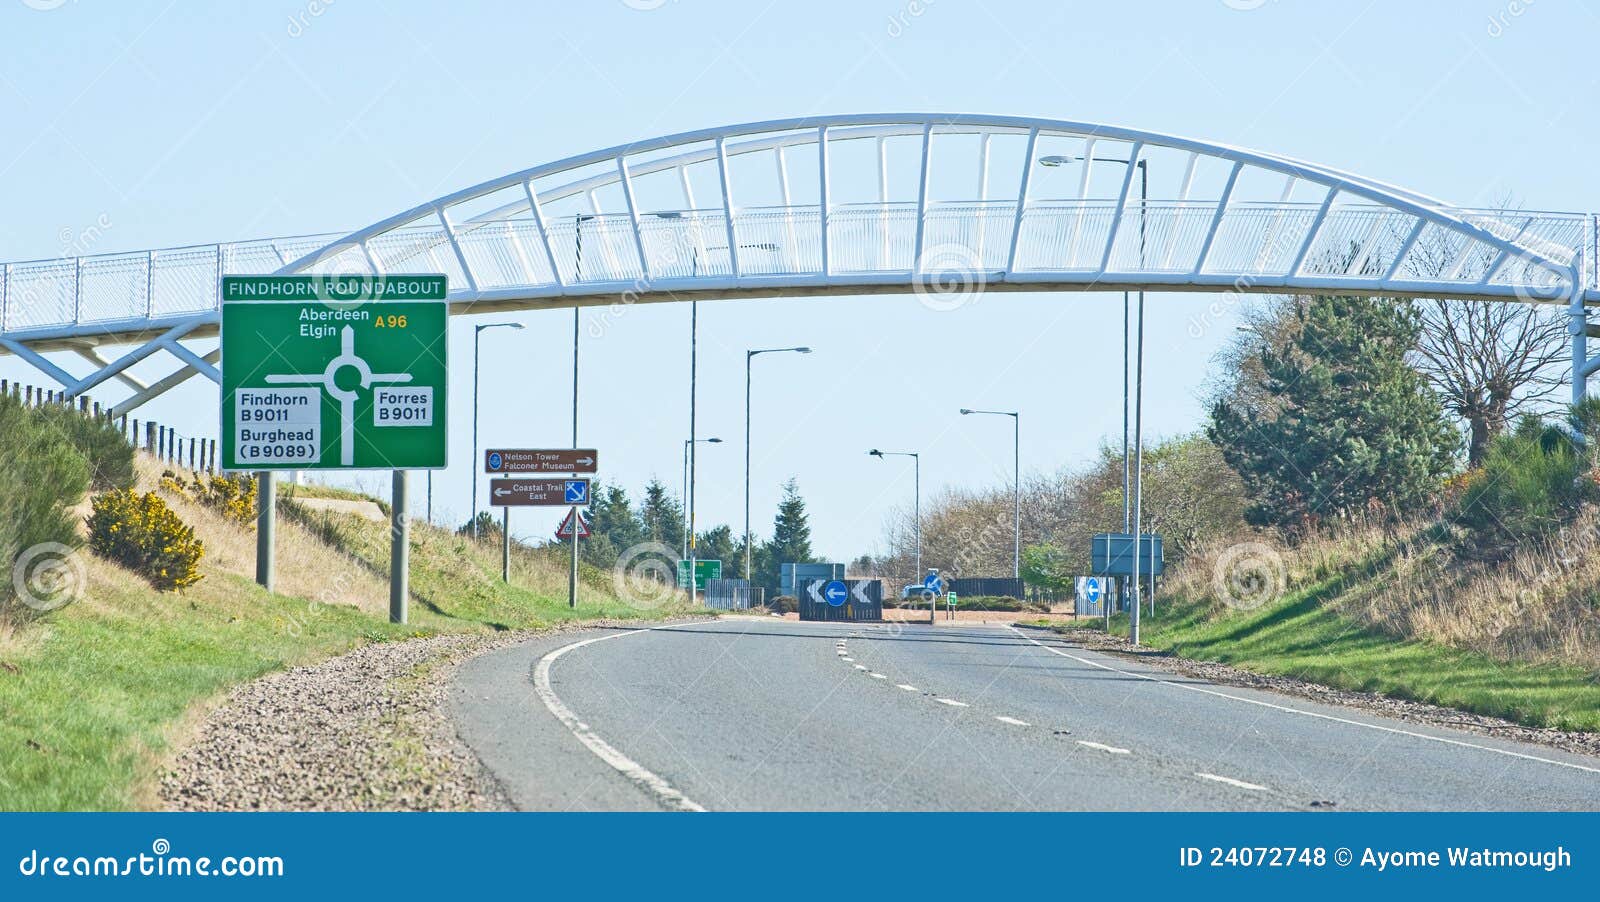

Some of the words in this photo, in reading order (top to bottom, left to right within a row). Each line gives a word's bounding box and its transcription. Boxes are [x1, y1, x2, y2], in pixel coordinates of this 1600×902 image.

[229, 282, 318, 296] FINDHORN
[325, 281, 441, 296] ROUNDABOUT
[299, 308, 369, 321] Aberdeen
[300, 324, 336, 339] Elgin
[241, 393, 308, 406] Findhorn
[380, 392, 428, 404] Forres
[241, 428, 313, 443] Burghead
[504, 453, 533, 461] Nelson
[536, 453, 560, 461] Tower
[542, 462, 575, 470] Museum
[512, 484, 543, 492] Coastal
[547, 483, 564, 492] Trail
